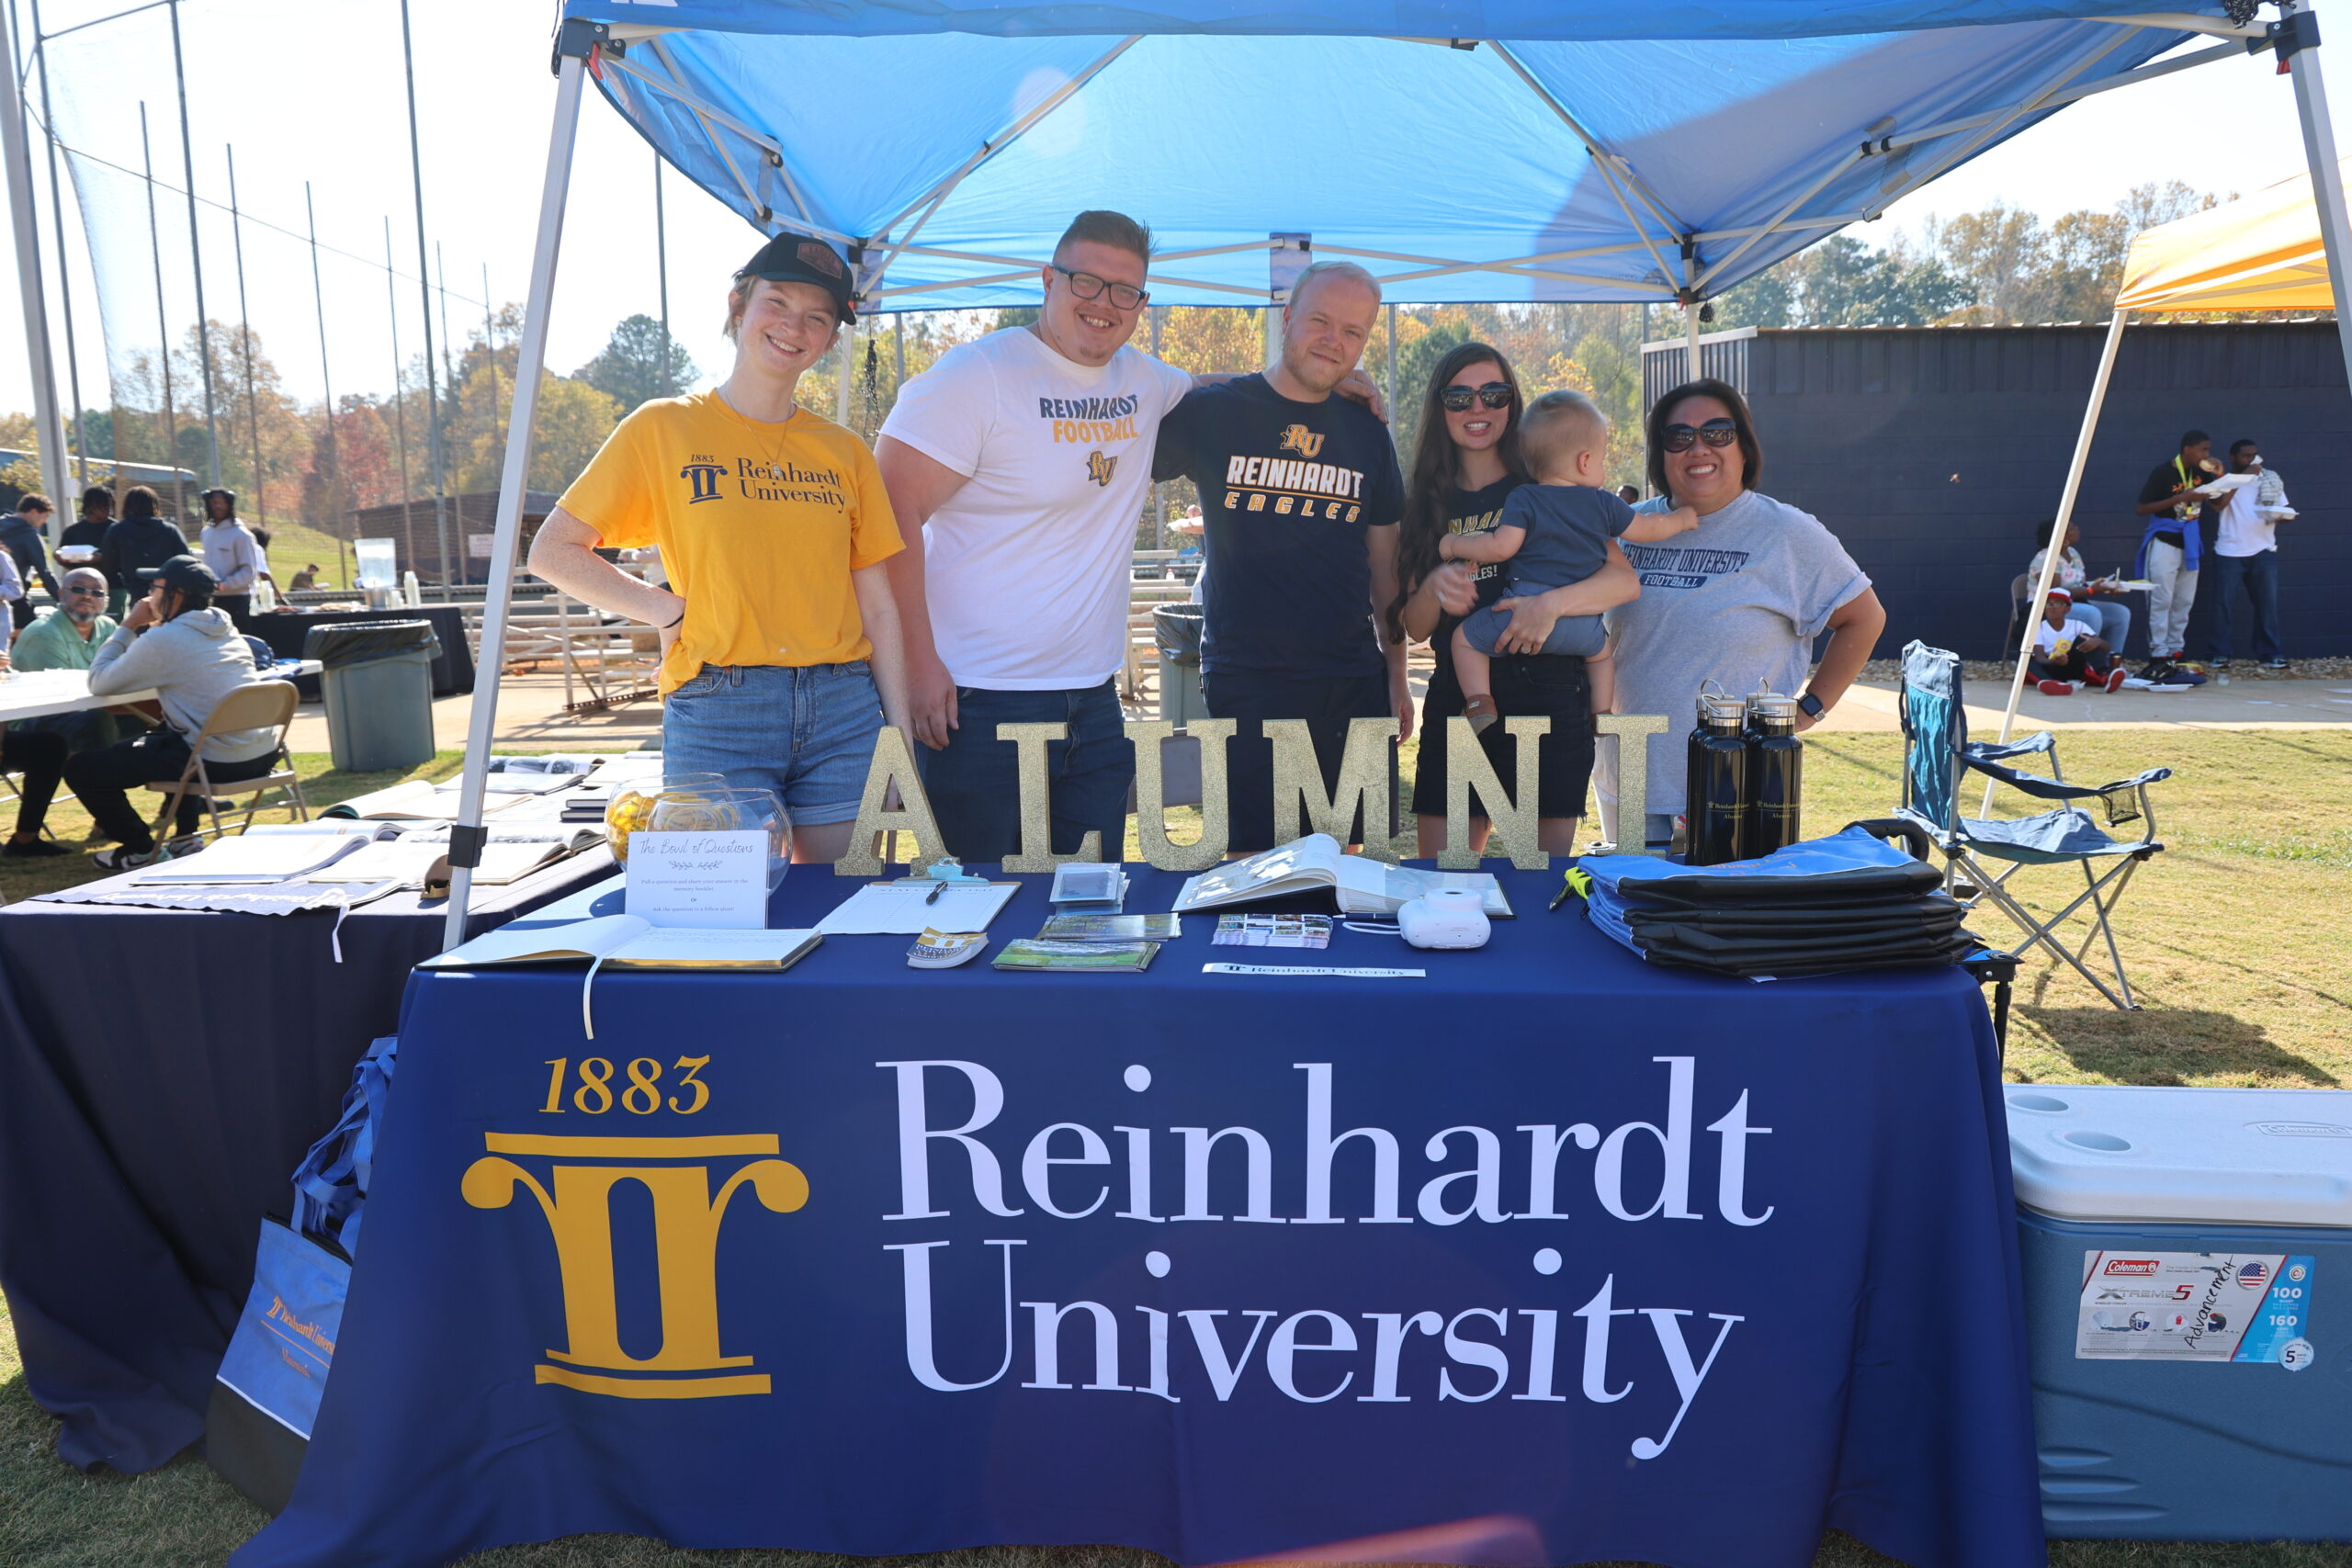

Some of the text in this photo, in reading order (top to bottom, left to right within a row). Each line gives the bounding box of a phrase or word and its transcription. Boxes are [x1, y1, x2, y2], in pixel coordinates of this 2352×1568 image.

[1039, 394, 1137, 420] REINHARDT
[1053, 416, 1139, 444] FOOTBALL
[1280, 423, 1326, 459] RU
[690, 454, 715, 463] 1883
[1227, 455, 1364, 499] REINHARDT
[738, 478, 845, 513] University
[1224, 491, 1361, 523] EAGLES
[1644, 573, 1698, 587] FOOTBALL
[833, 716, 1669, 877] ALUMNI
[639, 838, 753, 854] The Bowl of Questions
[538, 1055, 710, 1114] 1883
[876, 1055, 1775, 1226] Reinhardt
[2109, 1260, 2146, 1273] Coleman
[2184, 1254, 2236, 1349] Advancement
[2272, 1287, 2302, 1300] 100
[2268, 1314, 2299, 1327] 160
[883, 1238, 1745, 1460] University
[2285, 1350, 2296, 1364] 5
